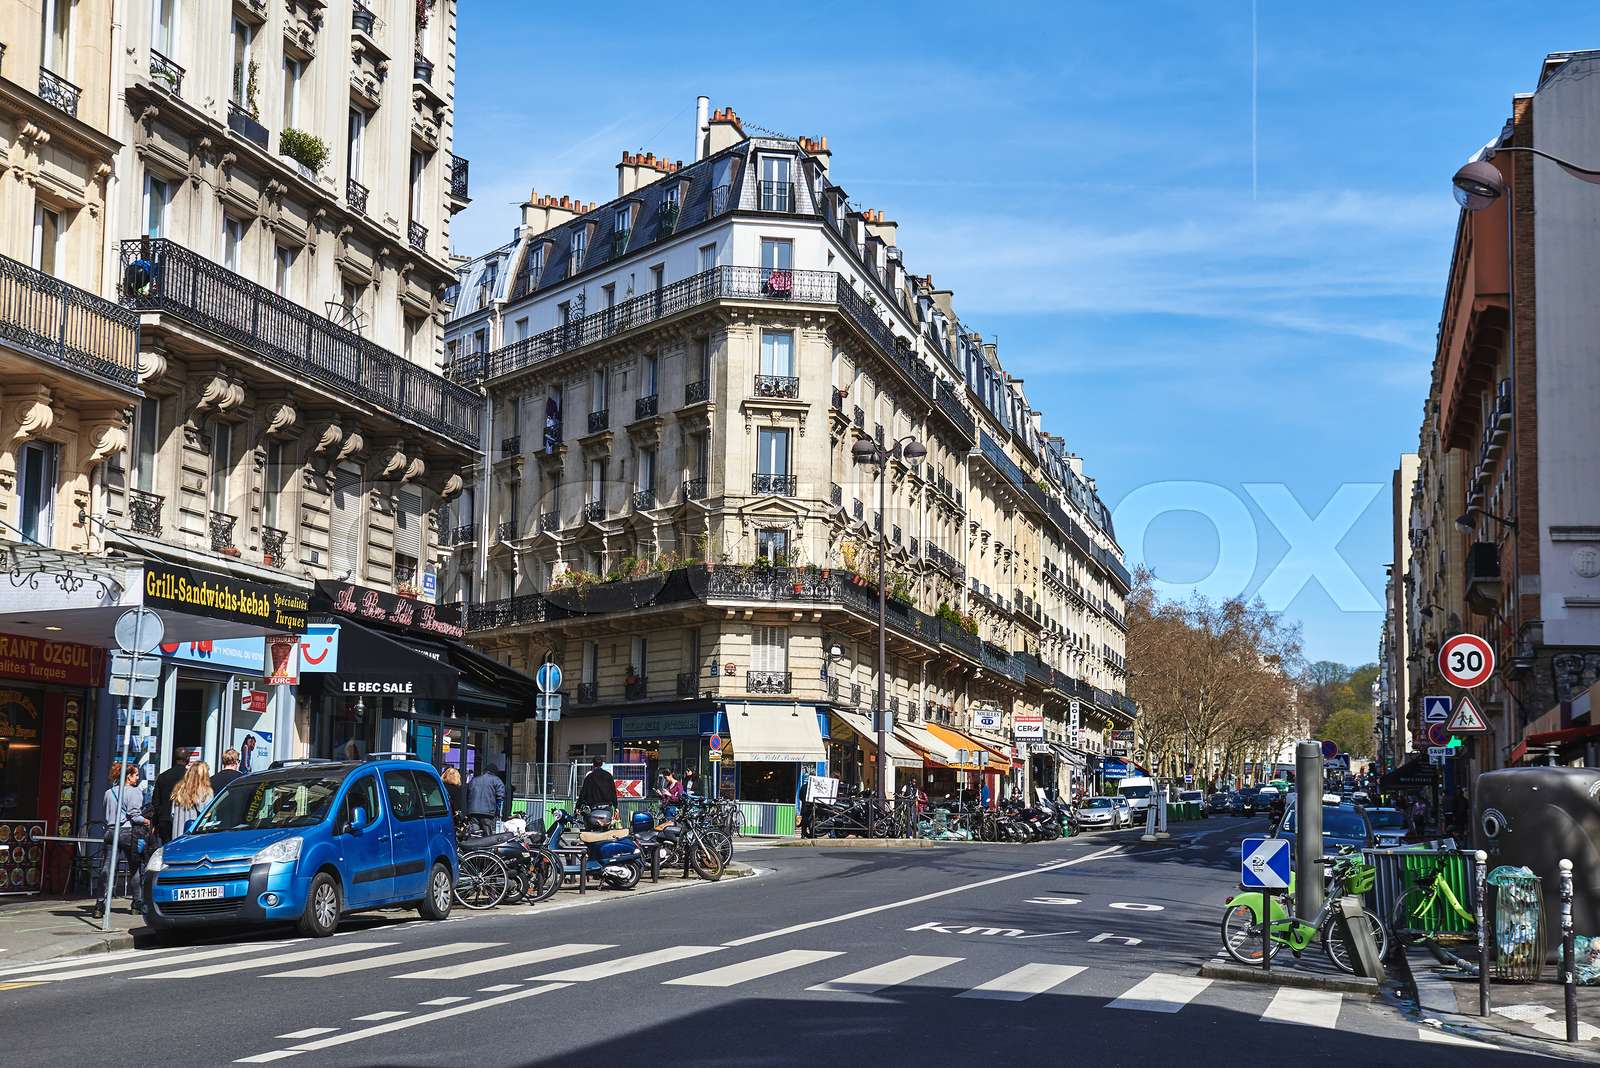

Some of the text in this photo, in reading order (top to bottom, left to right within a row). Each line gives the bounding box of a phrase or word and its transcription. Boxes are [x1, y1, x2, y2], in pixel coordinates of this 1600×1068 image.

[146, 570, 270, 618] Grill-Sandwichs-kebab
[275, 609, 305, 629] Turques
[31, 662, 67, 679] Turques
[1451, 650, 1483, 673] 30
[343, 681, 413, 694] LE BEC SALÉ
[179, 887, 218, 899] AM-317-HB
